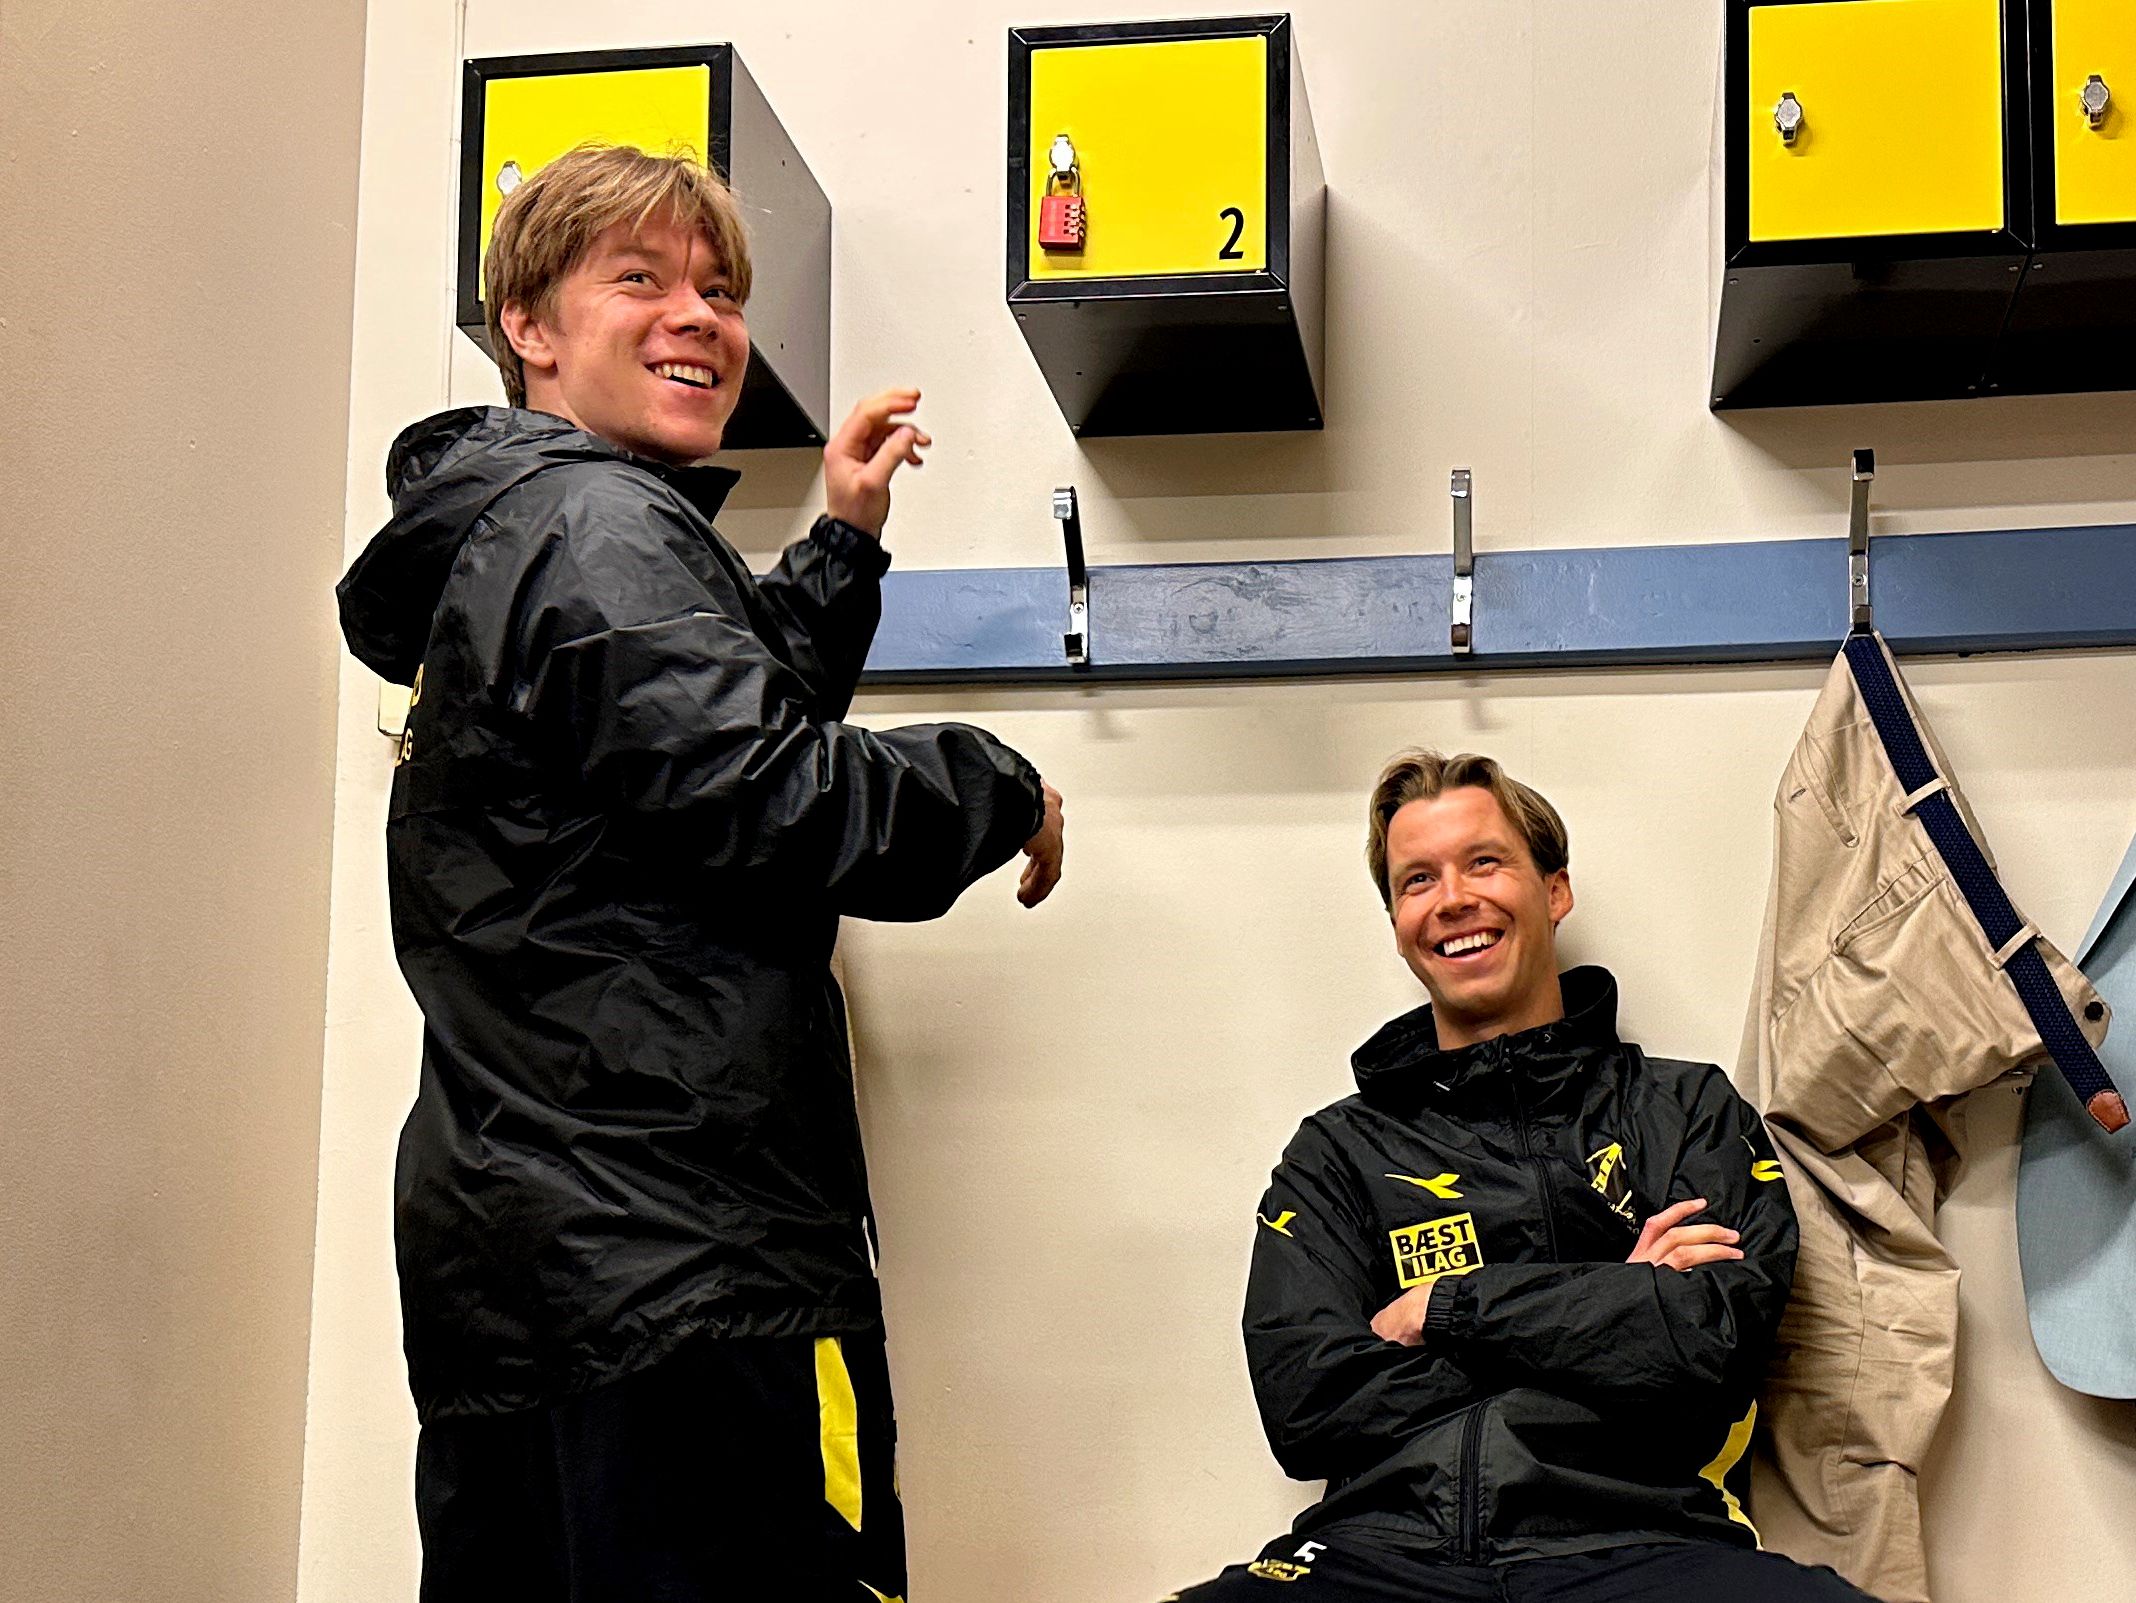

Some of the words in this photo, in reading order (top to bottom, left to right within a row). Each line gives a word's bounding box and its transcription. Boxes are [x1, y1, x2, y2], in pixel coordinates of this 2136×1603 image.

[1218, 207, 1245, 260] 2
[1395, 1218, 1470, 1255] BÆST
[1411, 1246, 1468, 1277] ILAG
